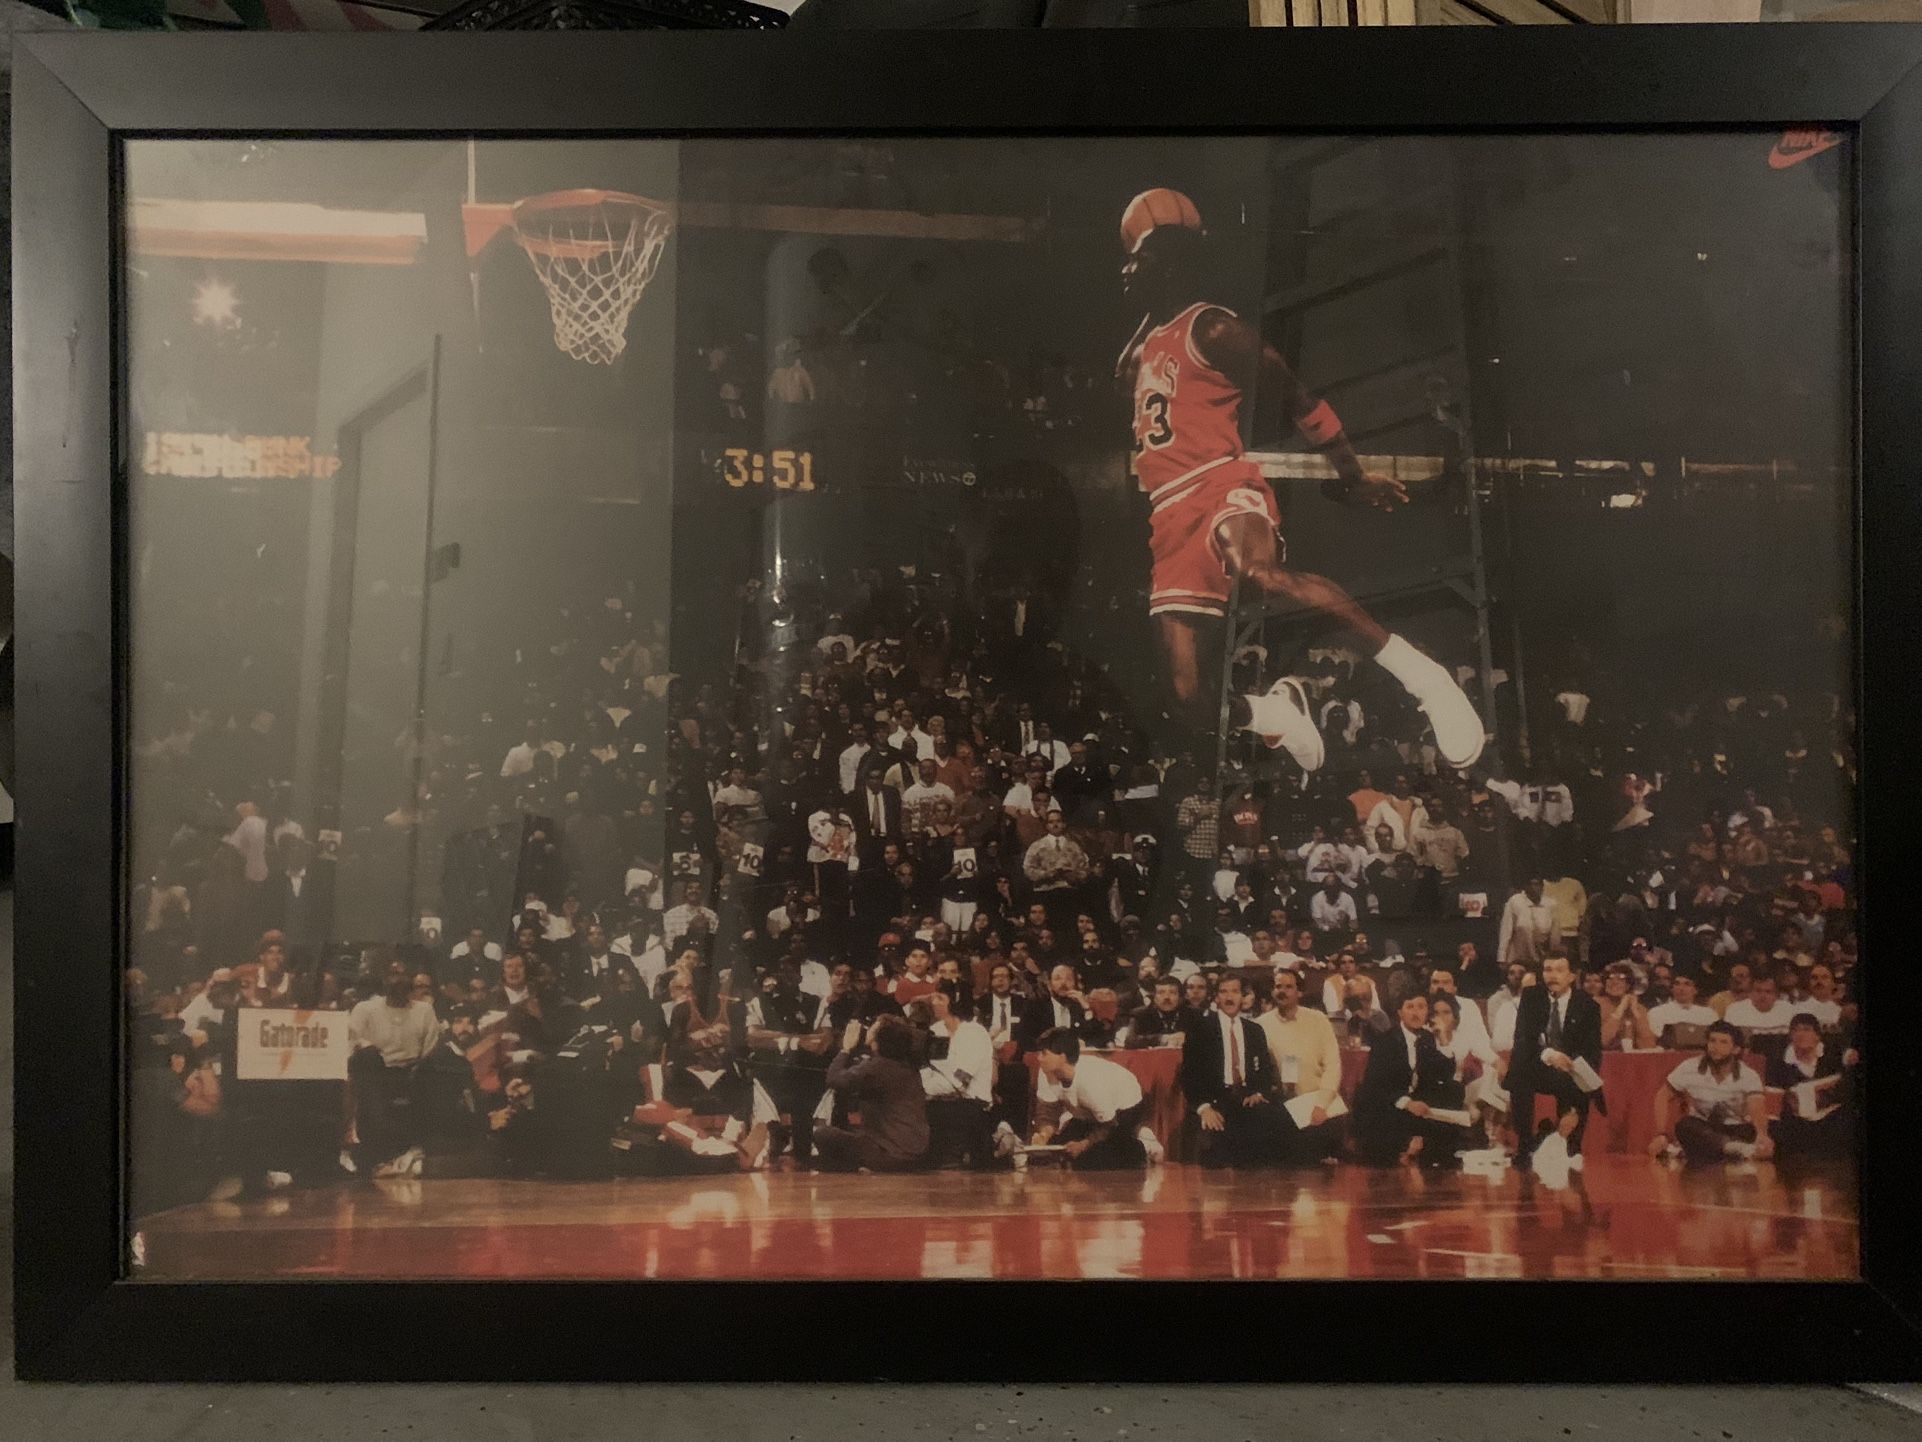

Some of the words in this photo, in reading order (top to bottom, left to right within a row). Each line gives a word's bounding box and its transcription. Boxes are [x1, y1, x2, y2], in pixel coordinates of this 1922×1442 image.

[724, 448, 815, 491] 3:51
[742, 852, 761, 869] 10
[259, 1019, 329, 1049] Gatorade
